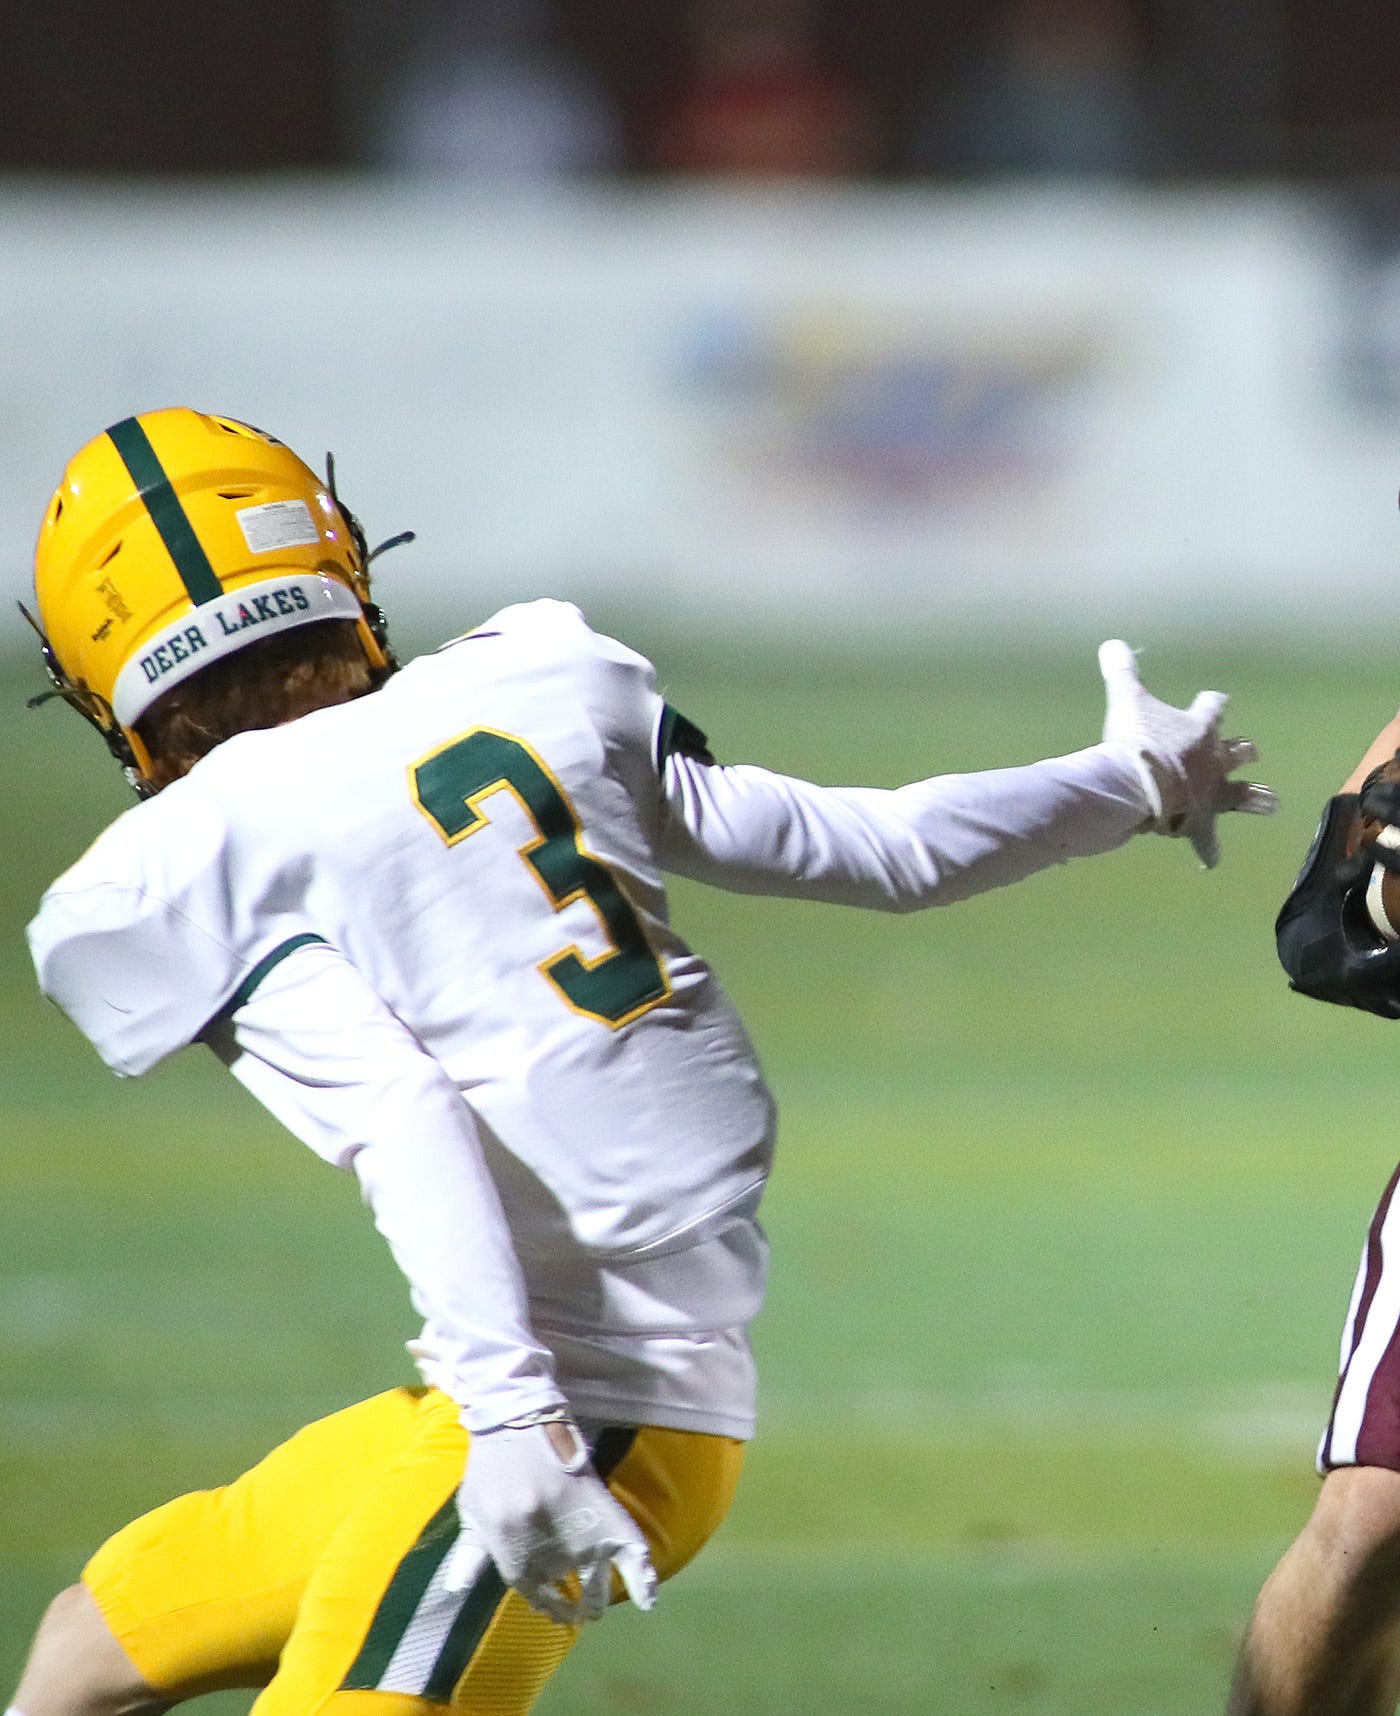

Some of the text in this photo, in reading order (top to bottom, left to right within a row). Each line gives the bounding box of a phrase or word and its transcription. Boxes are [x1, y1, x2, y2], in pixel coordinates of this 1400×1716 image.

[140, 586, 309, 683] DEER LAKES
[407, 725, 674, 1031] 3
